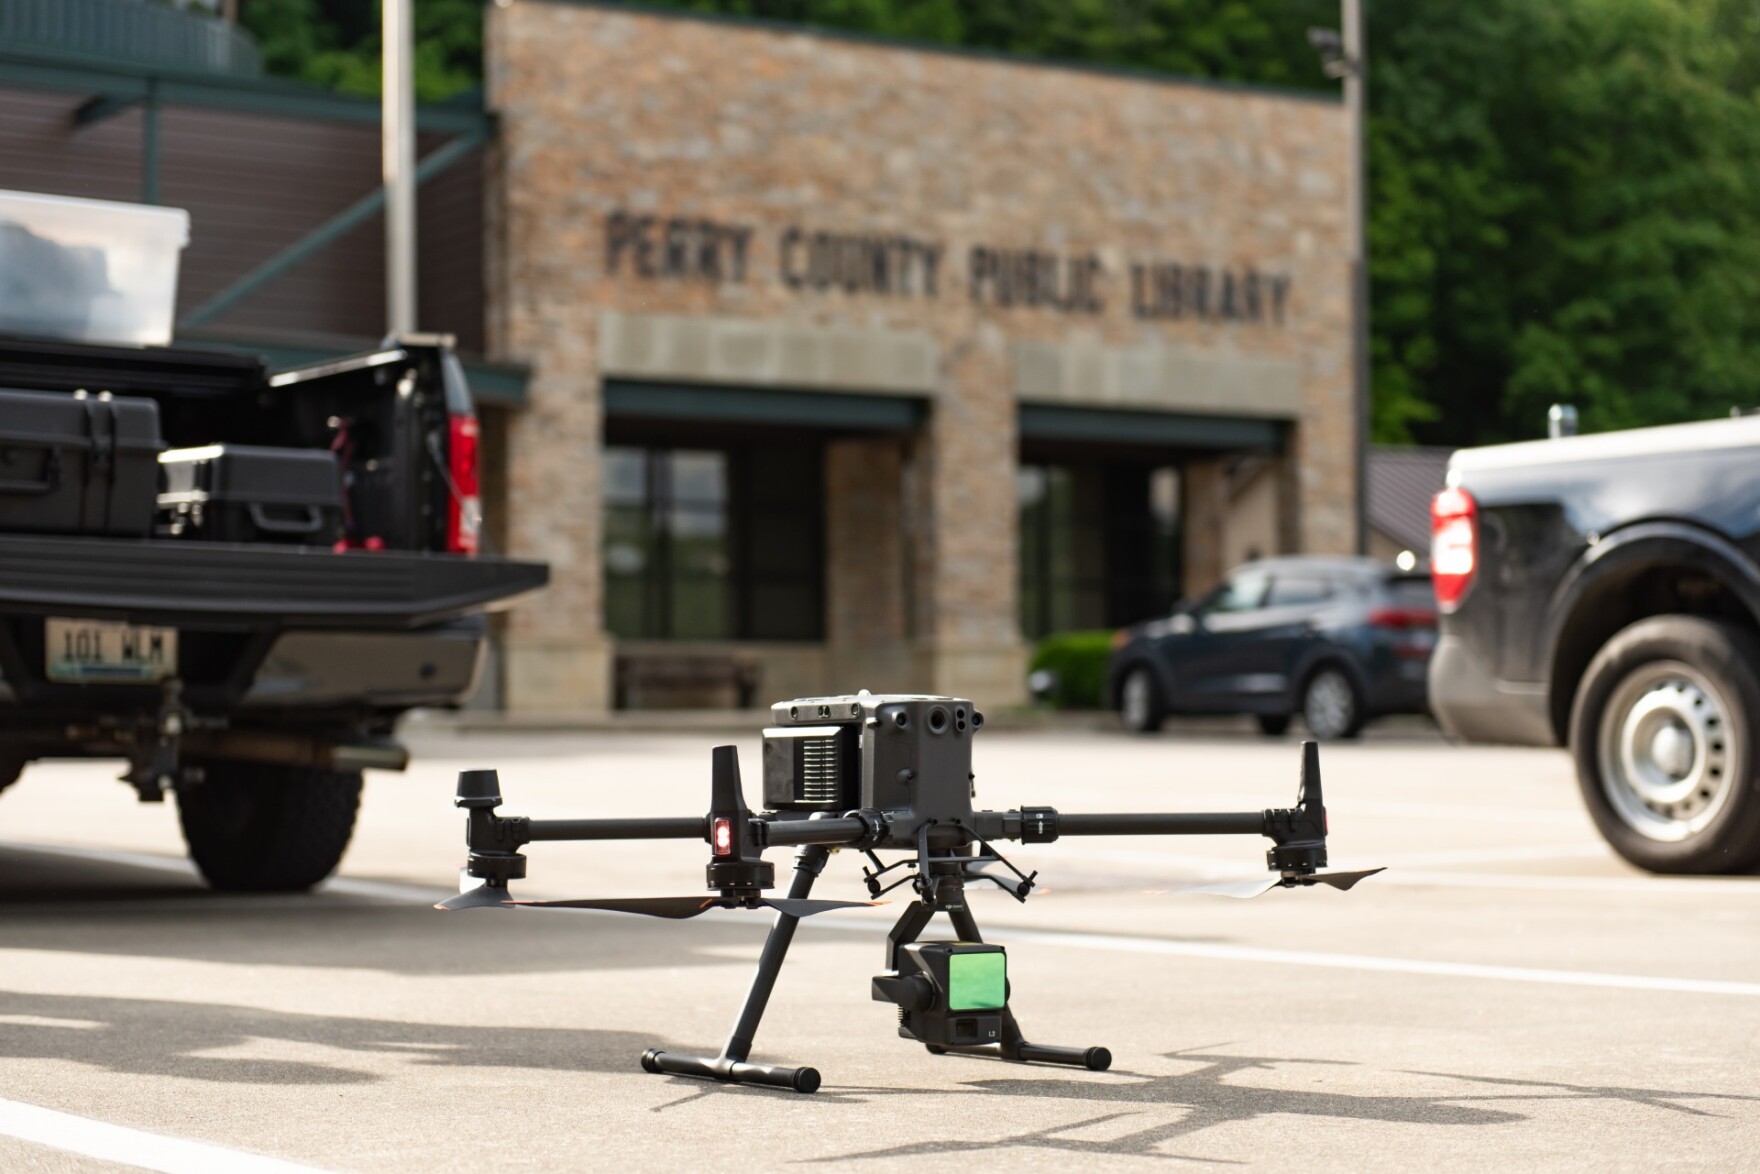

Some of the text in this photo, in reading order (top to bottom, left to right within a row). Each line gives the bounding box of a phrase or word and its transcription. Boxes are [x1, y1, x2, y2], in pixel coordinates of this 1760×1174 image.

[605, 211, 1292, 327] PERRY COUNTY PUBLIC LIBRARY
[64, 628, 103, 662] 101
